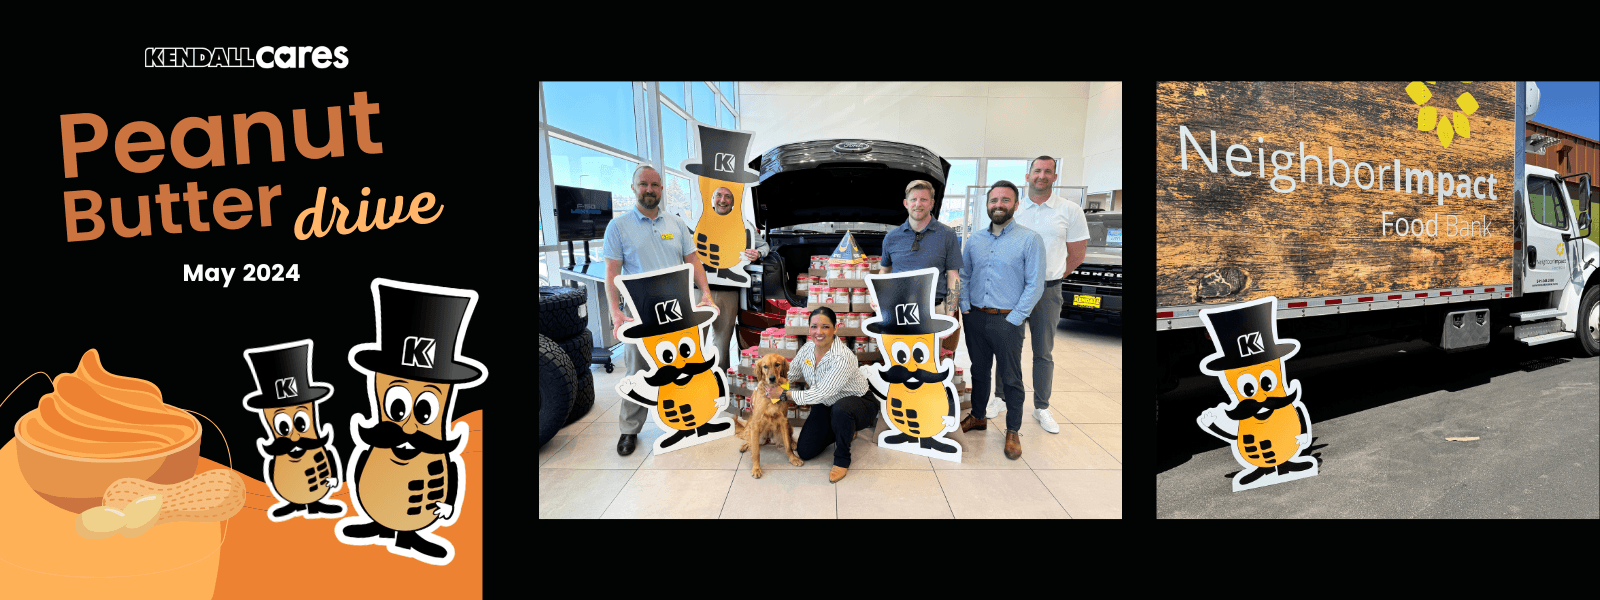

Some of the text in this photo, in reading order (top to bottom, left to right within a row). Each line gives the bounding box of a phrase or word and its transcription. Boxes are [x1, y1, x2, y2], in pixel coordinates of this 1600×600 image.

[715, 152, 735, 173] K
[1179, 125, 1498, 206] NeighborImpact
[1382, 211, 1491, 237] Food Bank
[655, 299, 682, 324] K
[896, 303, 920, 325] K
[1238, 332, 1264, 357] K
